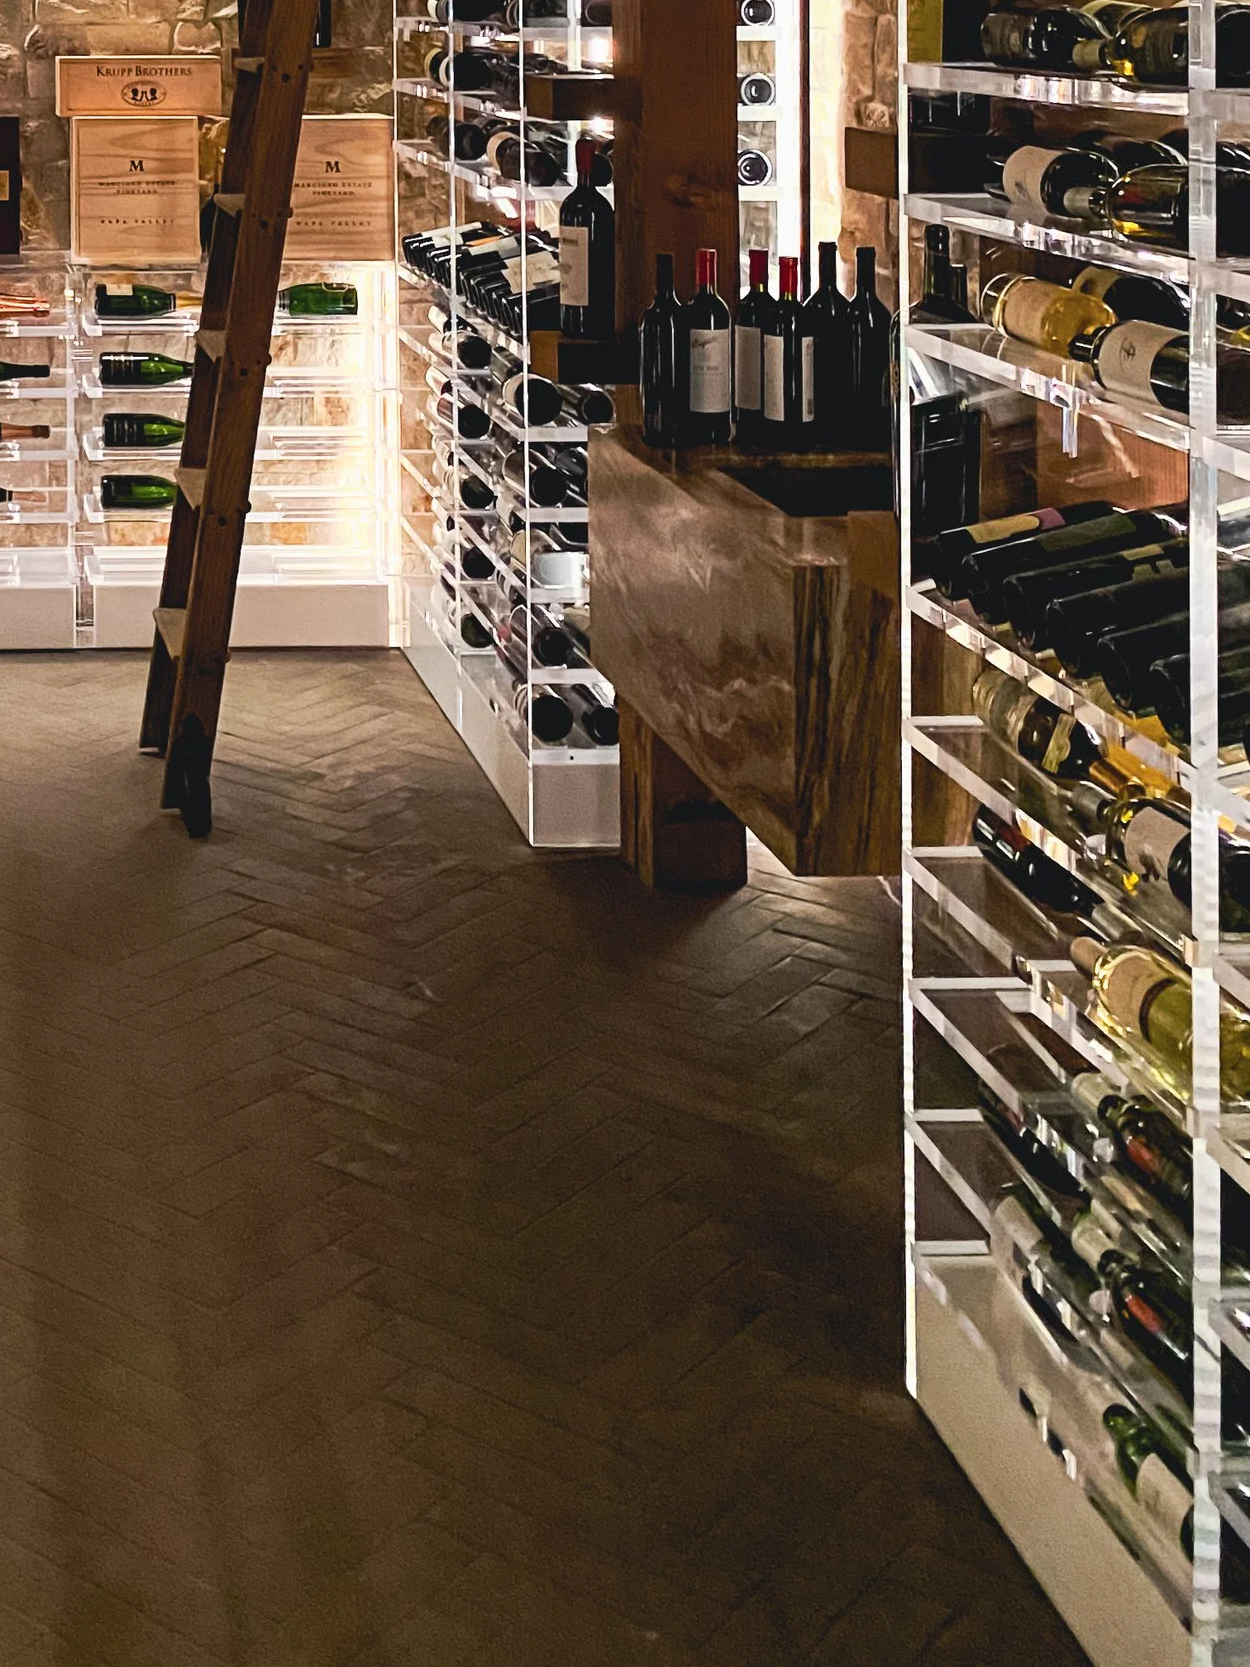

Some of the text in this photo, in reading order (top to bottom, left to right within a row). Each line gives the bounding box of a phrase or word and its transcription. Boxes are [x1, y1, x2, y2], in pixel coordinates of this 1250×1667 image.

[96, 65, 192, 77] KRUPP BROTHERS
[129, 160, 144, 172] M
[325, 161, 340, 173] M
